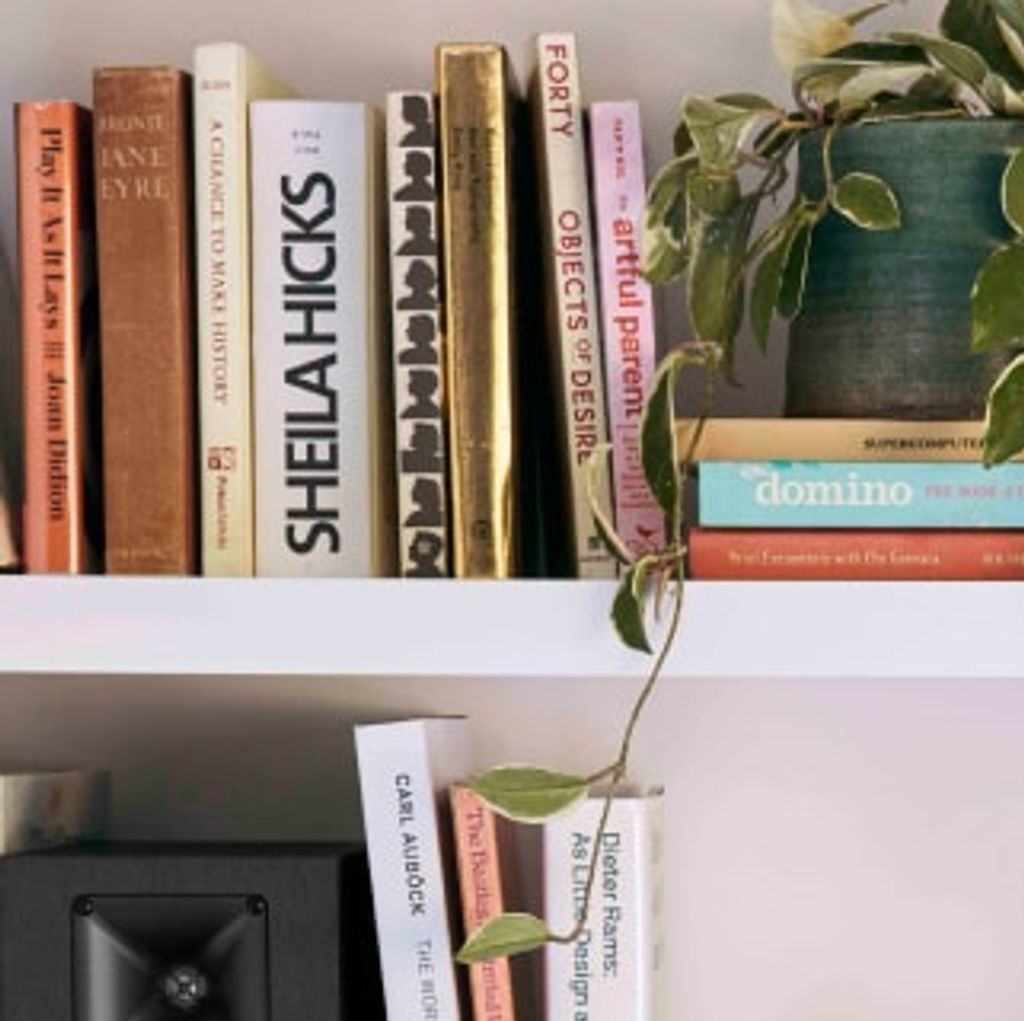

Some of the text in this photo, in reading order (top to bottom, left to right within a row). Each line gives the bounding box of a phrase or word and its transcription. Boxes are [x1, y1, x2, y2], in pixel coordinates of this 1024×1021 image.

[546, 45, 573, 138] FORTY
[101, 146, 169, 168] JANE
[101, 178, 170, 200] EYRE
[210, 136, 225, 216] CHANCE
[211, 228, 226, 254] TO
[281, 171, 337, 345] HICKS
[557, 210, 587, 331] OBJECTS
[613, 219, 643, 307] artful
[38, 128, 68, 521] Play It As It Lays Joan Didion
[211, 260, 227, 313] MAKE
[213, 321, 229, 406] HISTORY
[613, 316, 644, 419] parent
[285, 353, 341, 554] SHEILA
[571, 371, 598, 467] DESIRE
[755, 471, 913, 506] domino
[465, 806, 484, 849] The
[571, 832, 591, 862] As
[395, 774, 416, 827] CARL
[417, 938, 436, 974] THE
[601, 832, 621, 978] Dieter Rams:
[568, 928, 593, 1009] Design
